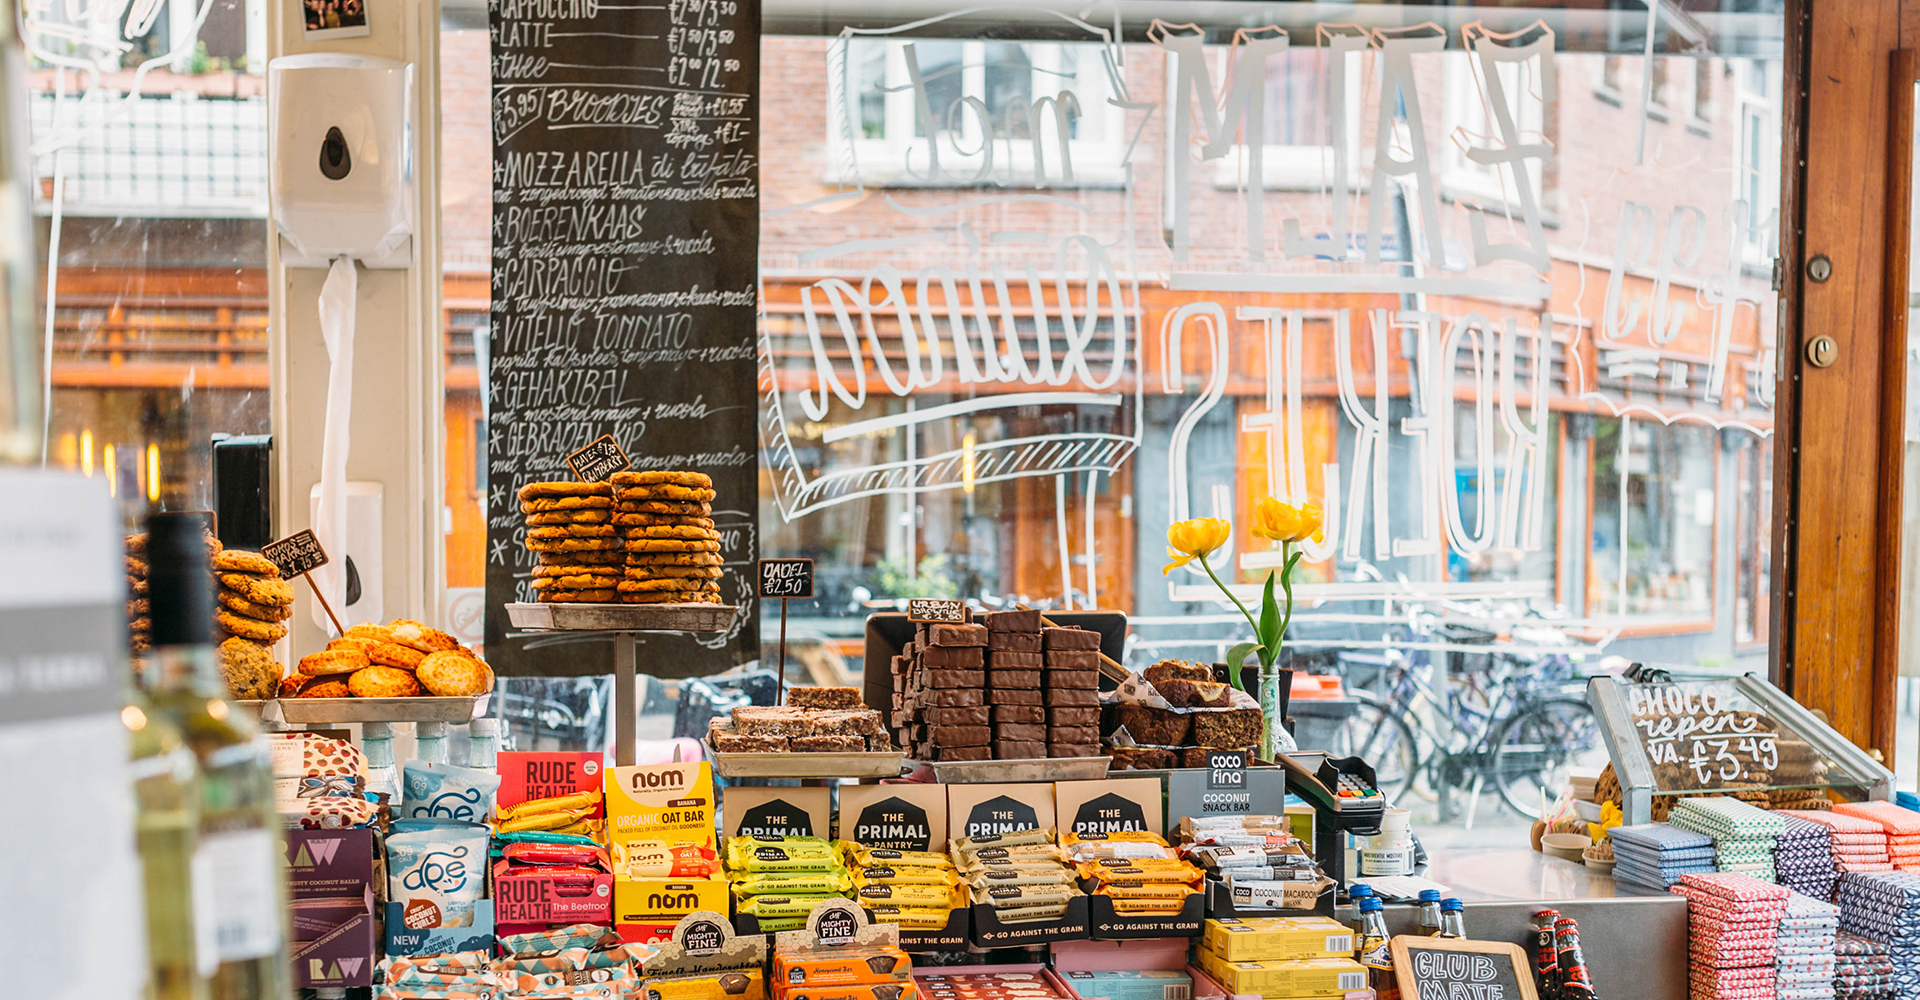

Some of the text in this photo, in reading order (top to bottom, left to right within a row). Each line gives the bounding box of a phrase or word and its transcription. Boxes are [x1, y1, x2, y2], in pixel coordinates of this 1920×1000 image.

[500, 21, 555, 48] LATTE
[502, 150, 645, 188] MOZZARELLA
[503, 204, 648, 245] BOERENKAAS
[594, 312, 693, 350] TONNATO
[504, 368, 644, 409] GEHAKTBAL
[507, 421, 602, 458] GEBRADEN
[265, 538, 296, 559] KOKOS
[763, 562, 808, 579] DADEL
[912, 600, 961, 610] URBAN
[1629, 685, 1722, 718] CHOCO
[1636, 713, 1758, 742] repen
[1211, 755, 1241, 768] coco
[527, 762, 576, 784] RUDE
[632, 769, 684, 788] nom
[1213, 769, 1242, 784] fina
[1203, 793, 1250, 803] COCONUT
[1099, 809, 1120, 818] THE
[1203, 803, 1250, 812] SNACK BAR
[617, 811, 705, 827] ORGANIC OAT BAR
[766, 816, 787, 824] THE
[882, 813, 904, 822] THE
[992, 811, 1014, 820] THE
[859, 825, 927, 839] PRIMAL
[1077, 820, 1144, 832] PRIMAL
[874, 841, 913, 849] PANTRY
[500, 880, 551, 903] RUDE
[1255, 889, 1318, 899] COCONUT MACAROON
[552, 903, 569, 911] The
[648, 893, 699, 909] nom
[405, 905, 437, 925] COCONUT
[500, 903, 551, 920] HEALTH
[412, 915, 437, 929] CURLS
[821, 920, 852, 928] MIGHTY
[1176, 922, 1199, 930] GRAIN
[320, 928, 345, 945] COCONUT
[345, 918, 362, 931] BALLS
[687, 932, 718, 940] MIGHTY
[822, 927, 851, 938] FINE
[1011, 929, 1042, 937] AGAINST
[1061, 925, 1083, 933] GRAIN
[393, 935, 420, 945] NEW
[424, 936, 456, 954] COCONUT
[688, 939, 718, 949] FINE
[1538, 952, 1556, 963] OLA
[309, 957, 364, 980] RAW
[1414, 952, 1497, 982] CLUB
[1418, 980, 1504, 1000] MATE
